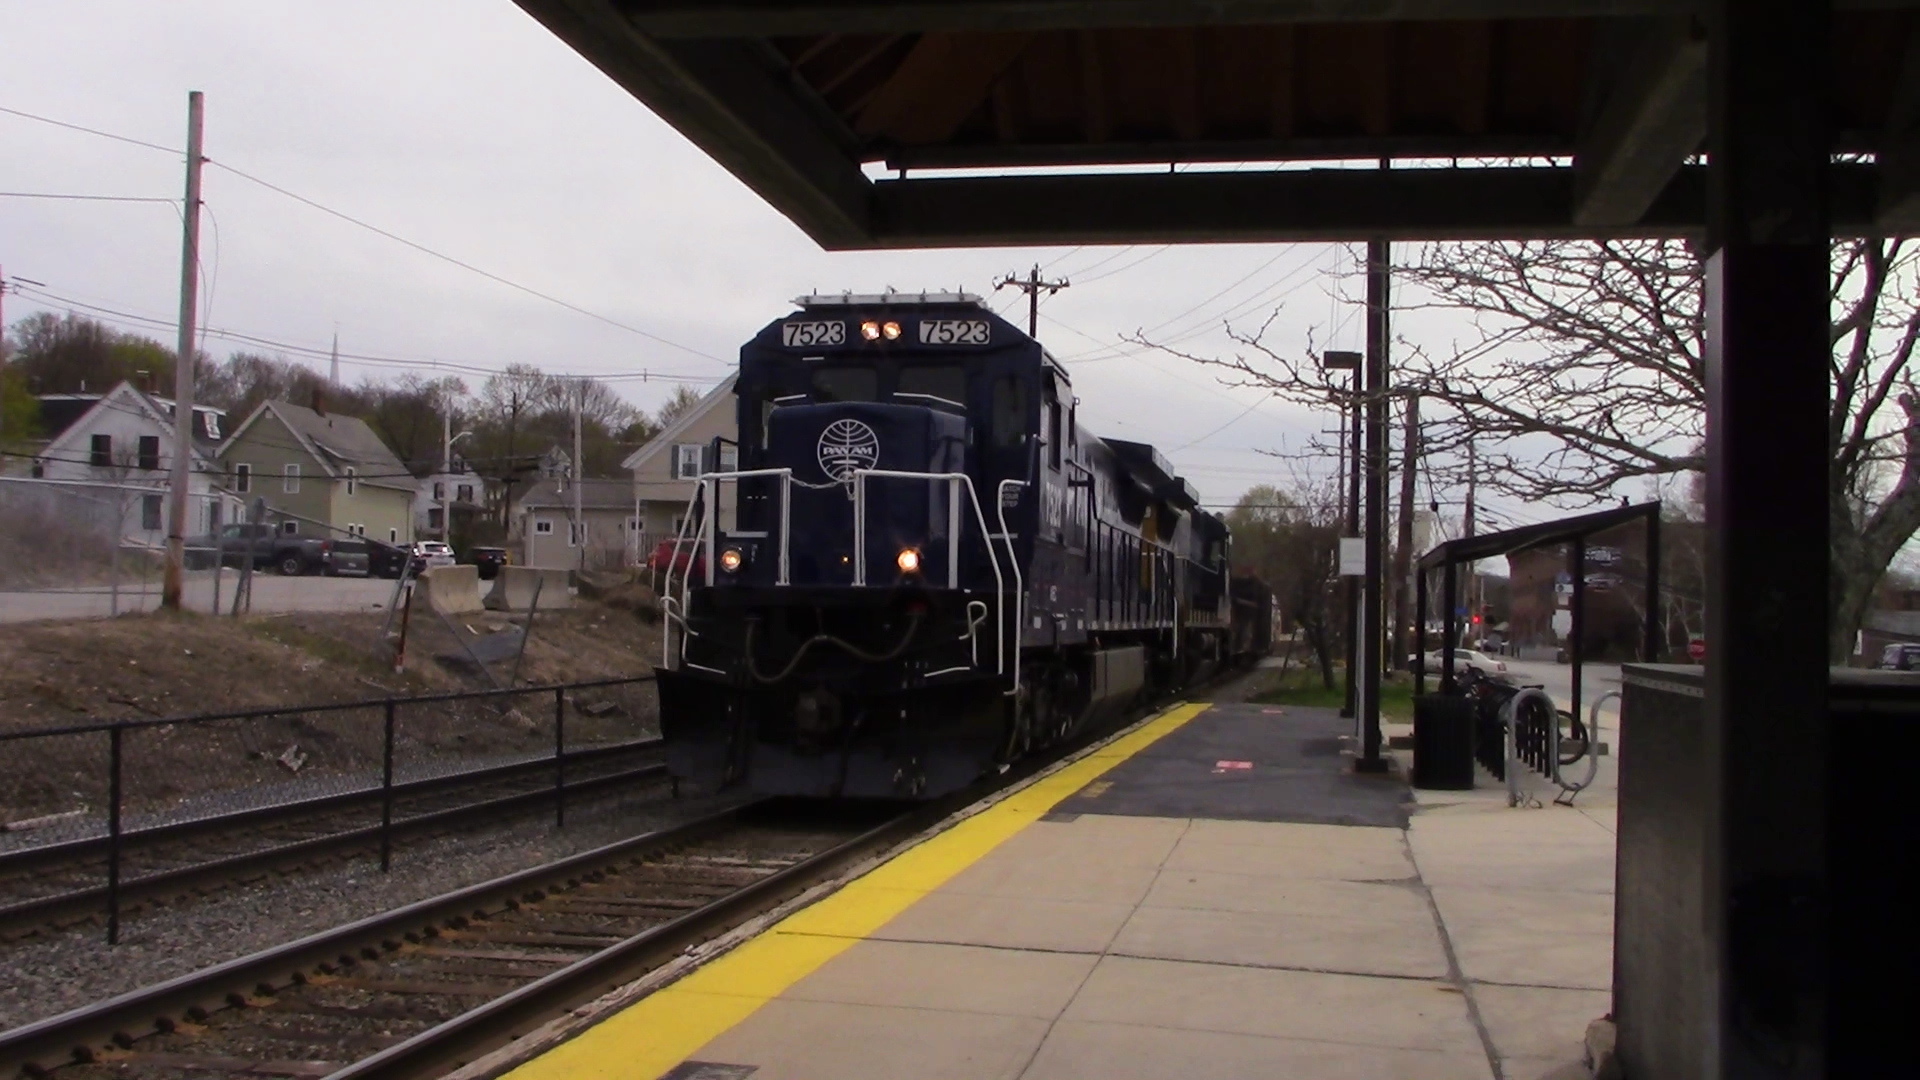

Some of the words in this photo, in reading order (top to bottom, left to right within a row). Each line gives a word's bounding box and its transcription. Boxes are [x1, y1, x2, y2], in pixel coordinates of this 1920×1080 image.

[785, 322, 844, 346] 7523
[922, 320, 989, 343] 7523
[823, 446, 849, 456] PAN
[850, 446, 873, 456] AM
